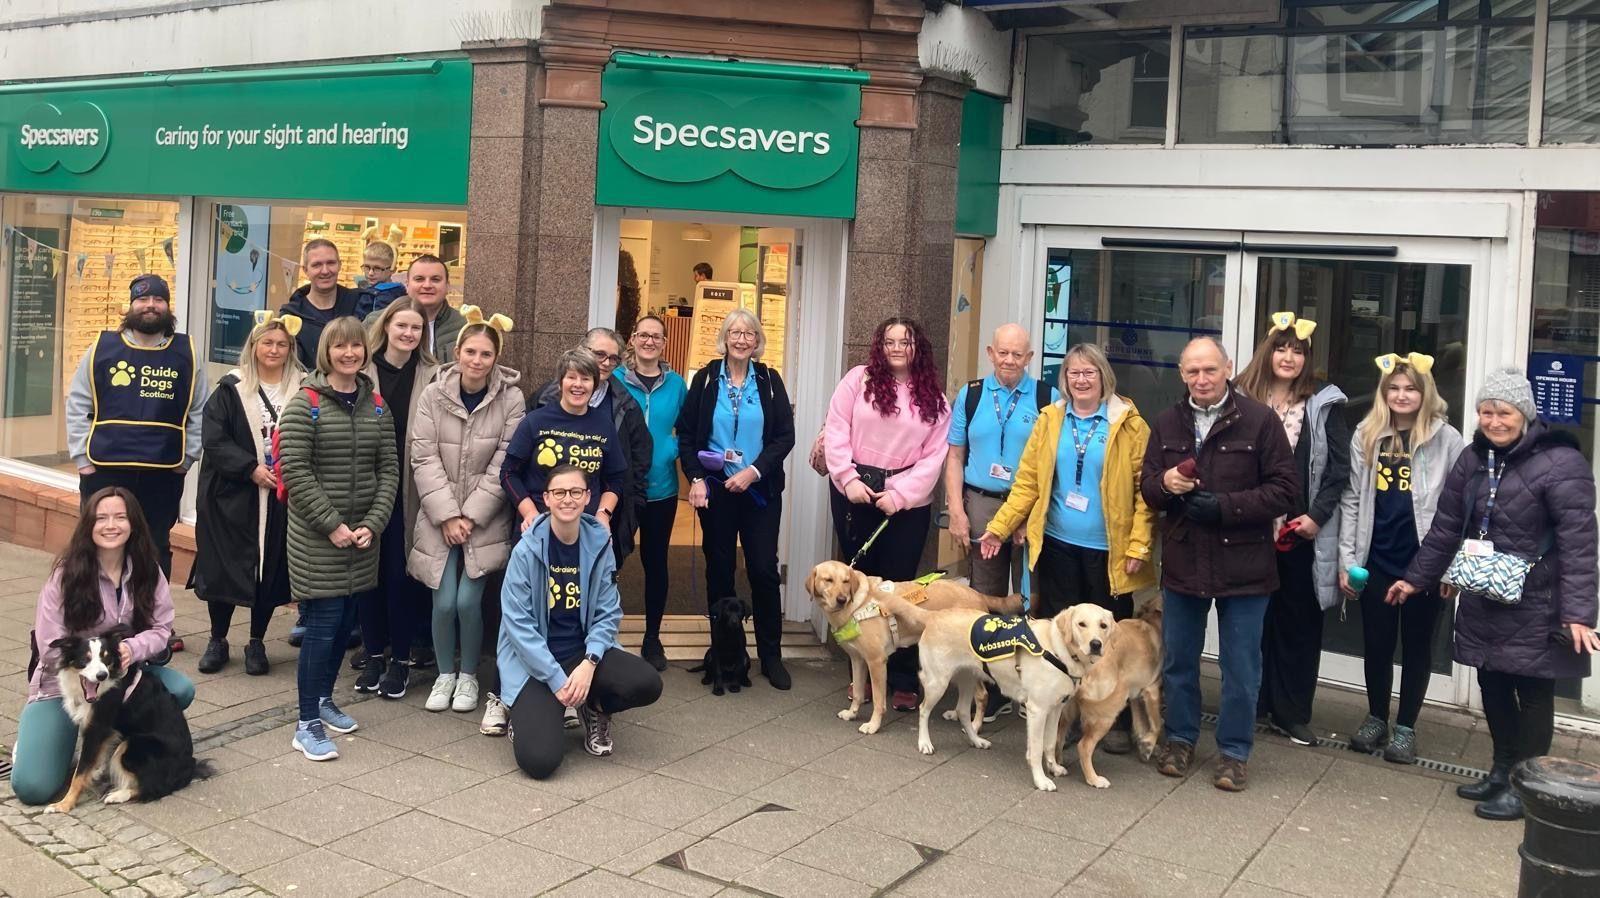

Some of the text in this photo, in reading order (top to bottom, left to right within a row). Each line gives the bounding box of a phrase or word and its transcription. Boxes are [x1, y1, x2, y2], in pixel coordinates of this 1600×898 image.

[20, 124, 99, 149] Specsavers
[155, 122, 409, 150] Caring for your sight and hearing
[633, 115, 830, 156] Specsavers
[141, 365, 179, 379] Guide
[141, 376, 173, 391] Dogs
[140, 389, 175, 400] Scotland
[550, 429, 585, 441] fundraising
[568, 444, 604, 458] Guide
[569, 456, 601, 473] Dogs
